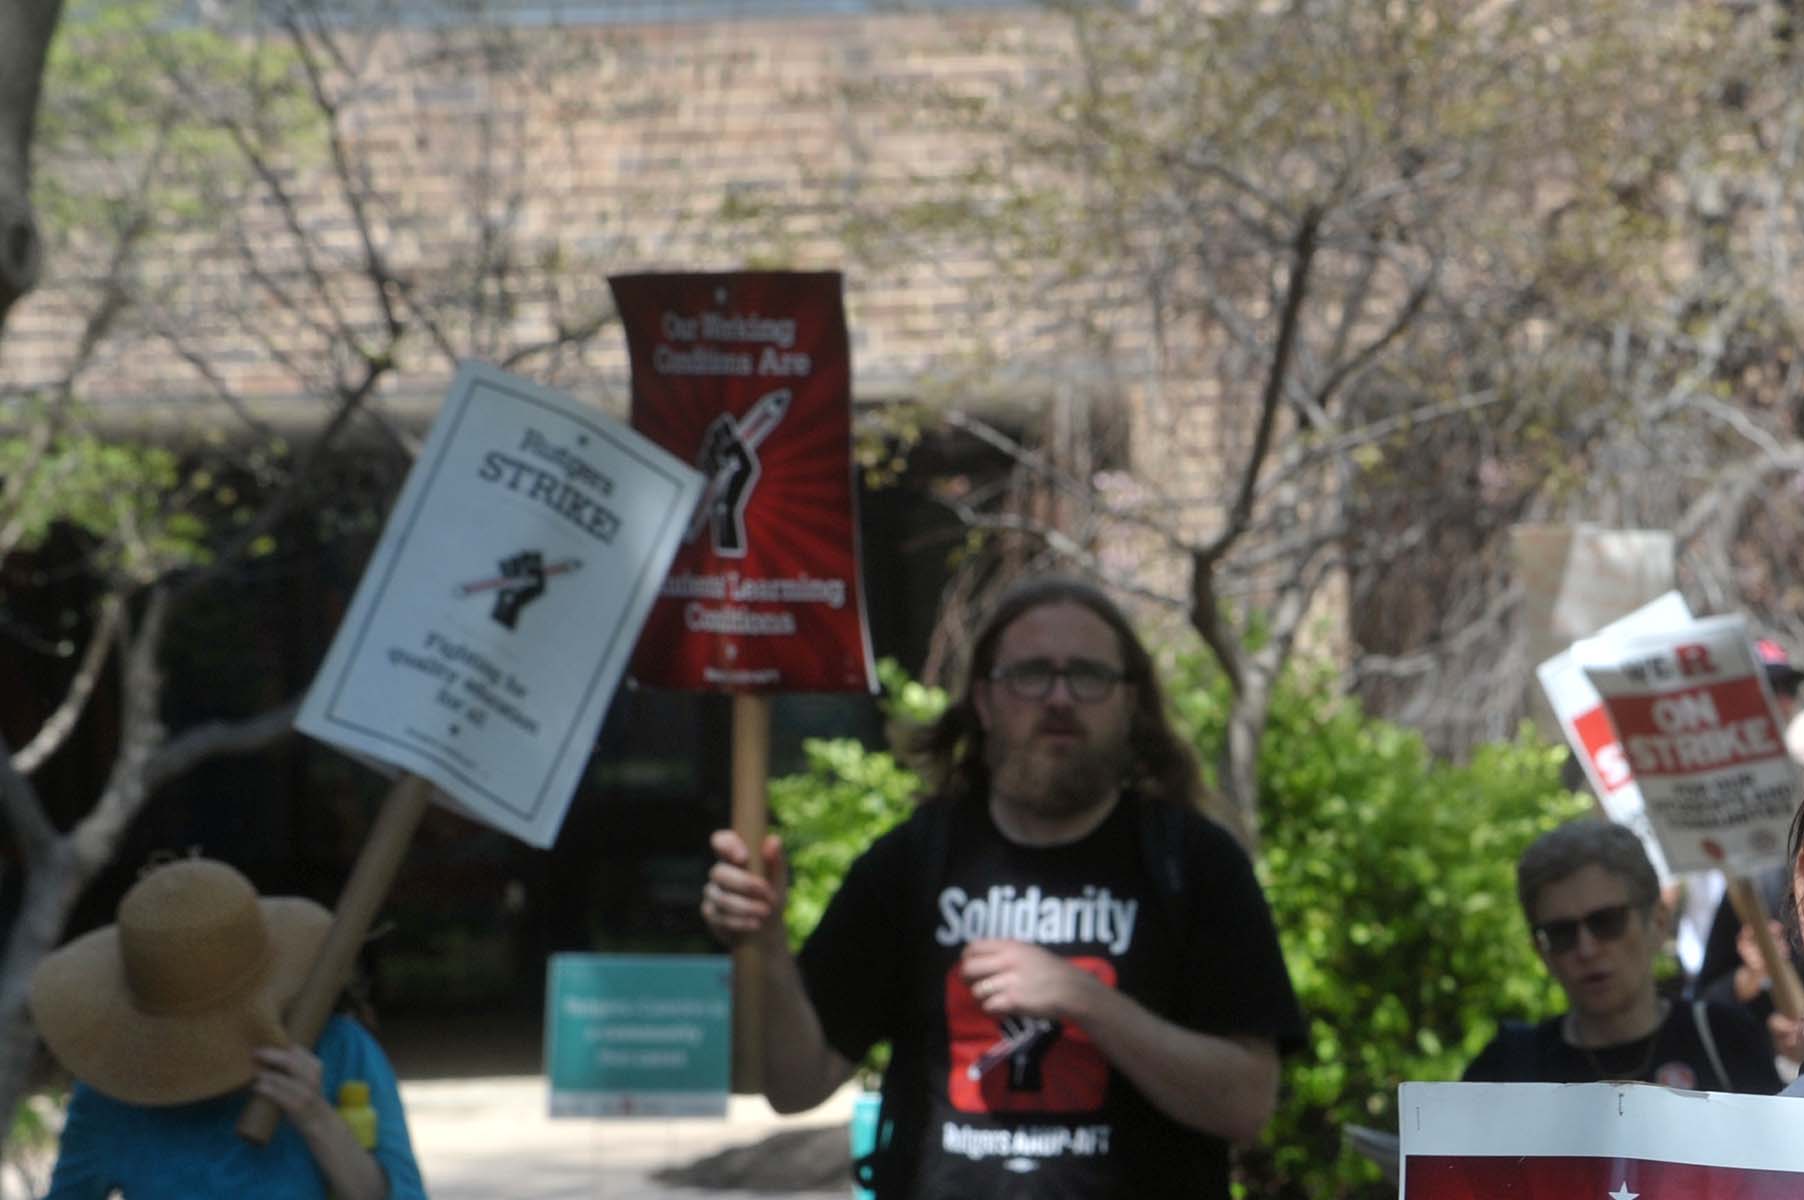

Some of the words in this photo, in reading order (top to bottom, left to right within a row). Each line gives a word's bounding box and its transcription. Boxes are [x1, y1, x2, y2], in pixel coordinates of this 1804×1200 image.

[757, 346, 812, 378] Are
[1674, 644, 1718, 677] R
[1653, 691, 1719, 735] ON
[1627, 717, 1779, 771] STRIKE
[935, 885, 1138, 956] Solidarity
